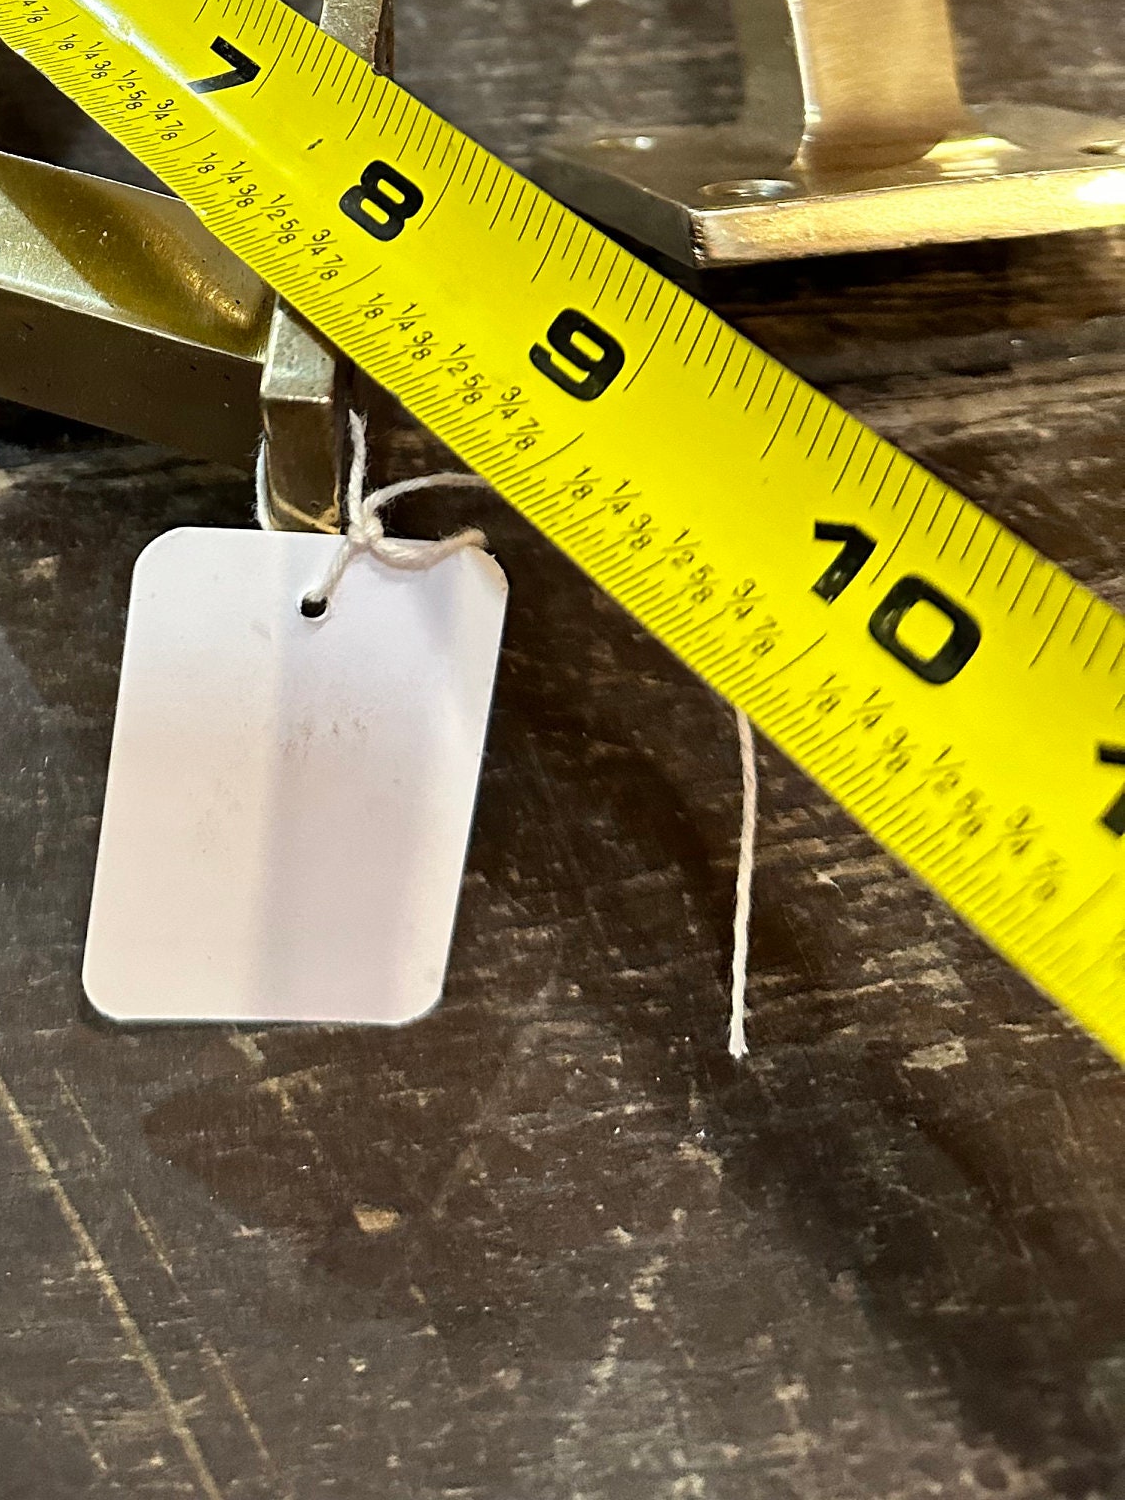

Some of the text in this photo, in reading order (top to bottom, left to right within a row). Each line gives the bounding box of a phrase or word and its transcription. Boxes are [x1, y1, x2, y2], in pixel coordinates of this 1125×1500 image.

[186, 35, 261, 94] 7
[338, 159, 424, 242] 8
[528, 307, 625, 401] 9
[810, 518, 982, 685] 10
